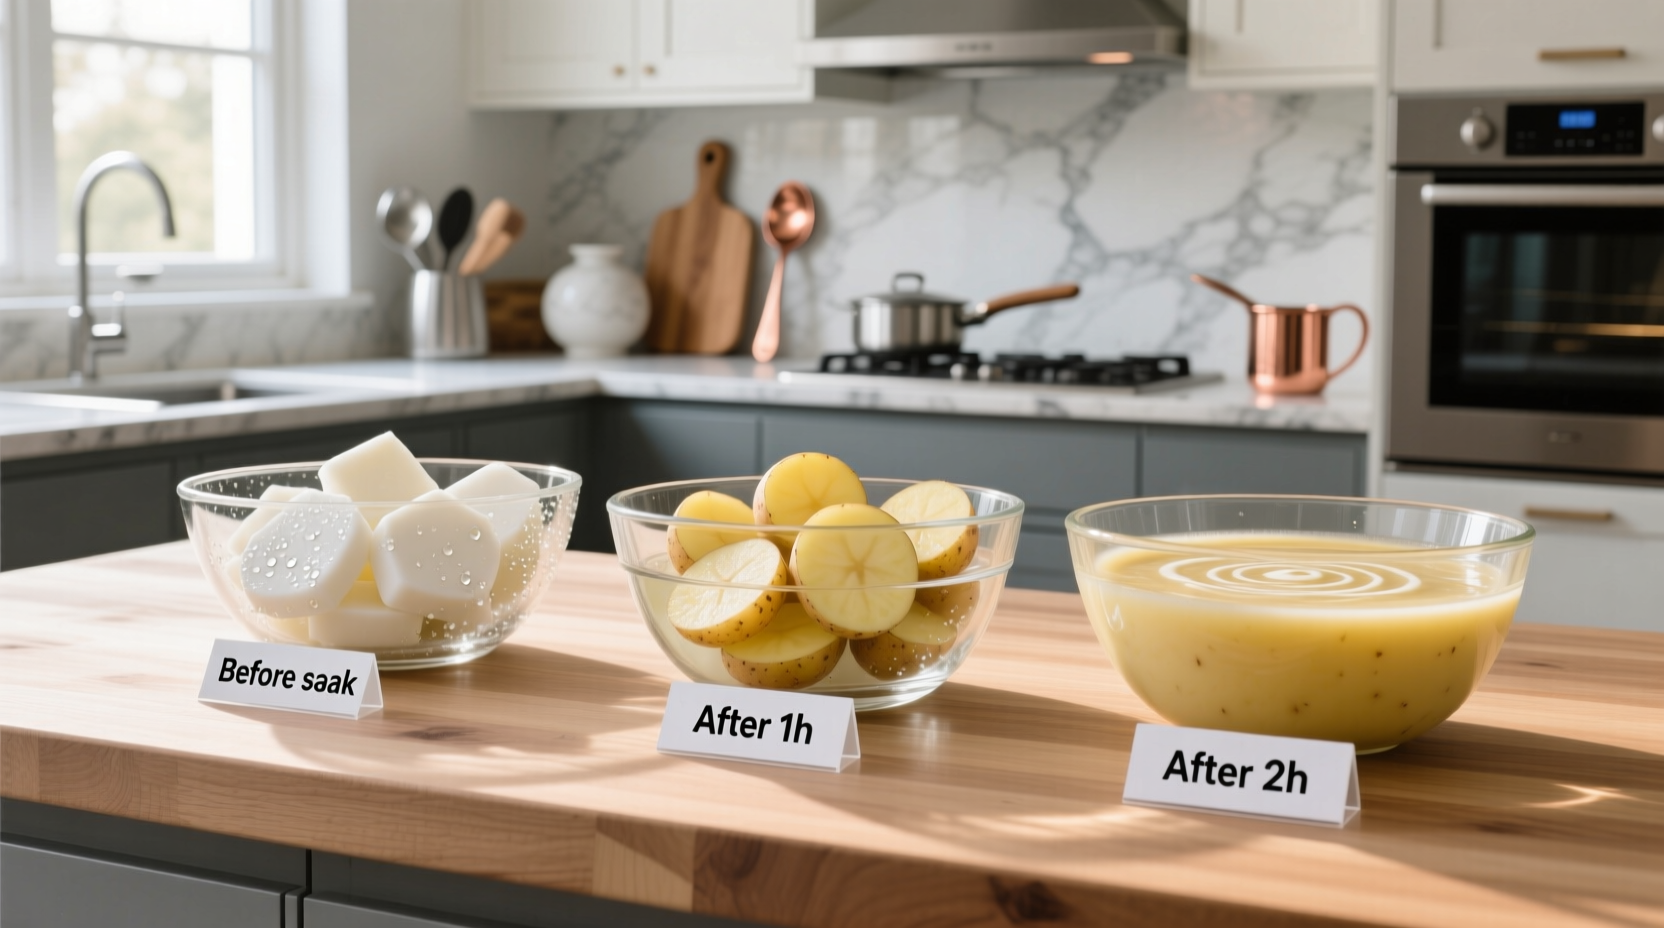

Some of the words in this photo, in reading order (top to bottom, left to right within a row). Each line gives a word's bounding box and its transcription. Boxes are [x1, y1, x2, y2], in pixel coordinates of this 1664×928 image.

[218, 657, 296, 689] Before
[301, 669, 358, 696] saak
[692, 704, 773, 740] After
[780, 712, 814, 745] 1h
[1162, 749, 1254, 788] After
[1262, 759, 1309, 795] 2h
